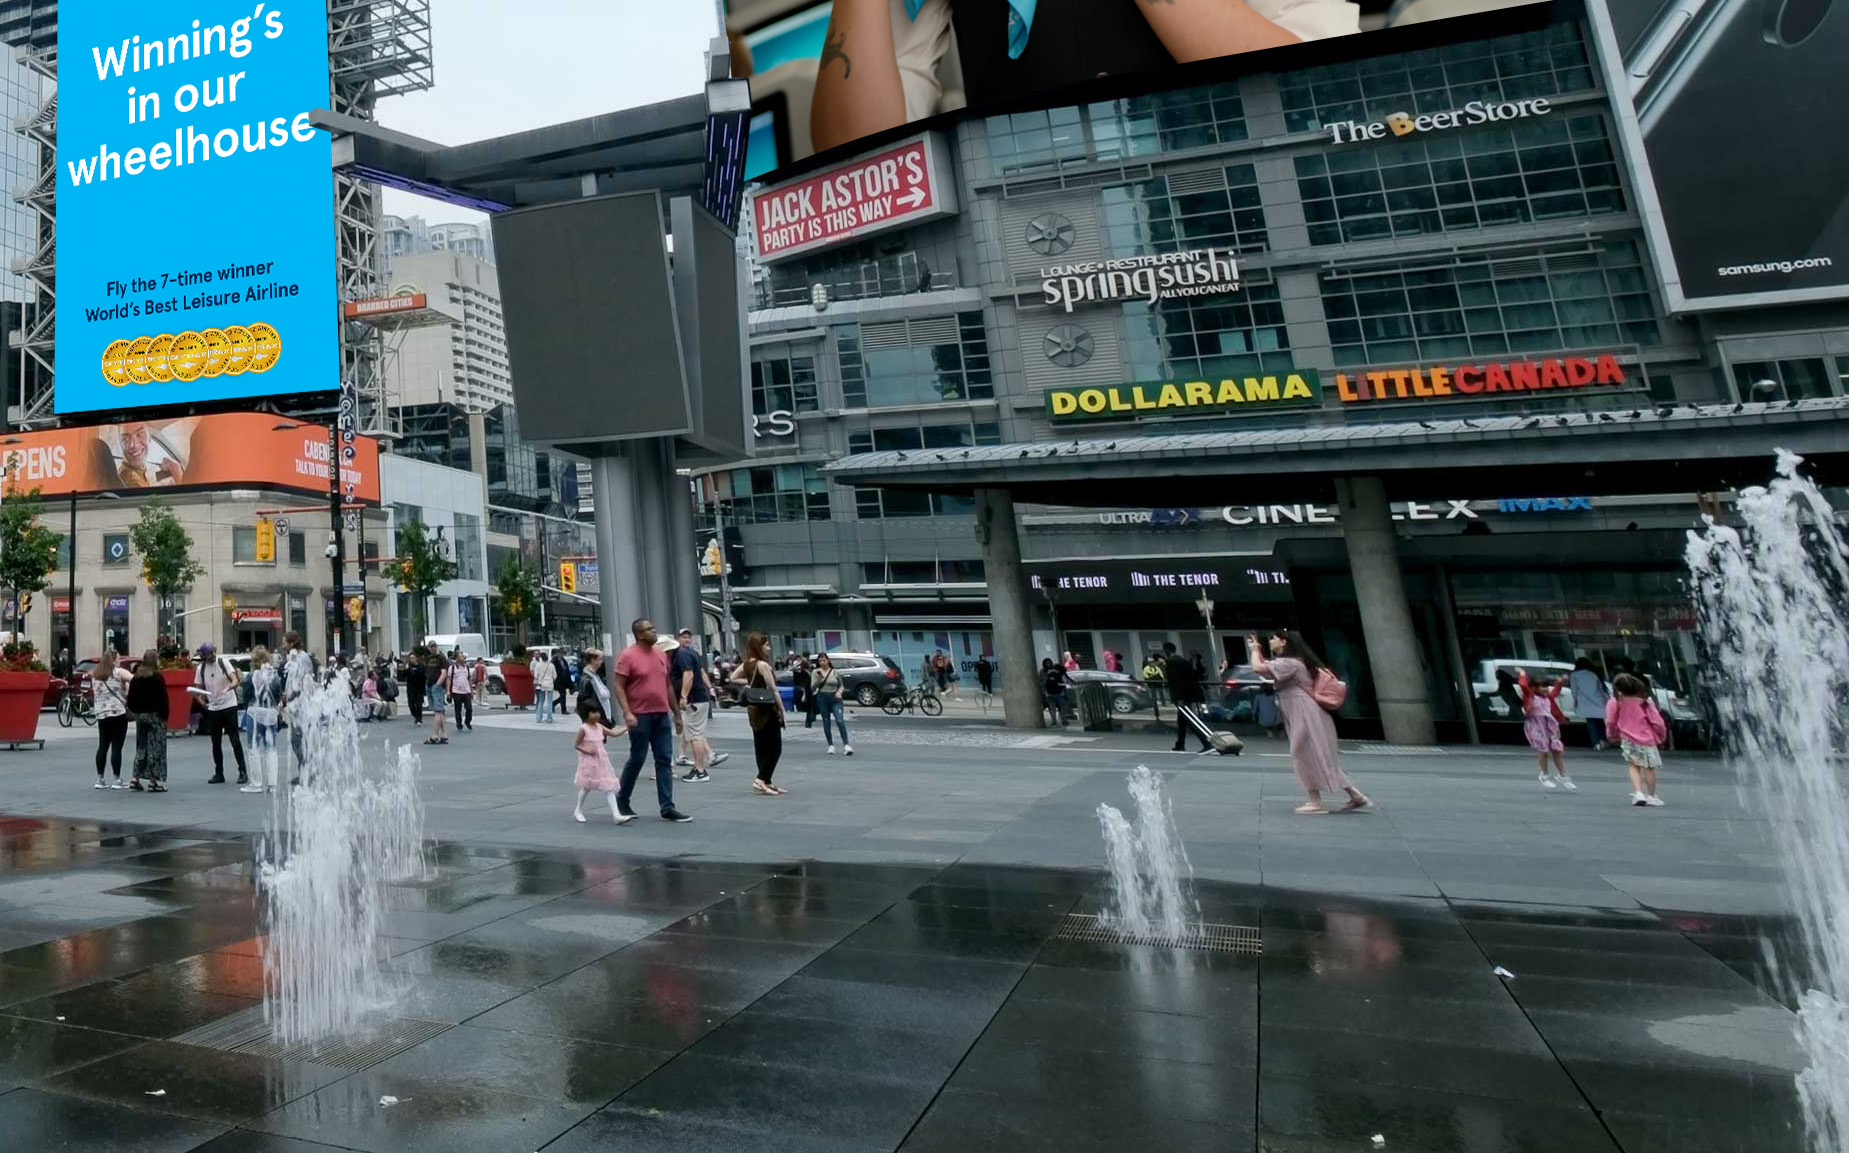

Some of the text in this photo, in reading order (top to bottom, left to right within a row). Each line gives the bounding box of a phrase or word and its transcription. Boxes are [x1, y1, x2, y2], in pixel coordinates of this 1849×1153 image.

[128, 72, 245, 124] in our
[1324, 98, 1551, 145] The Beer Store
[68, 112, 317, 186] wheelhouse
[762, 186, 815, 231] JACK
[763, 222, 805, 251] PARTY
[808, 218, 822, 239] IS
[824, 207, 856, 233] THIS
[859, 195, 892, 222] WAY
[107, 261, 273, 298] Fly the 7-time winner
[1041, 250, 1202, 278] LOUNGE RESTAURANT
[1043, 248, 1240, 313] spring sushi
[1719, 256, 1832, 278] samsung.com
[145, 297, 177, 315] Best
[183, 291, 240, 311] Leisure
[245, 282, 299, 302] Airline
[1052, 373, 1313, 416] DOLLARAMA
[1336, 353, 1625, 401] LITTLE CANADA
[1099, 512, 1151, 525] ULTRA
[1498, 497, 1592, 512] IMAX
[1073, 576, 1107, 588] TENOR
[1153, 573, 1219, 587] THE TENOR
